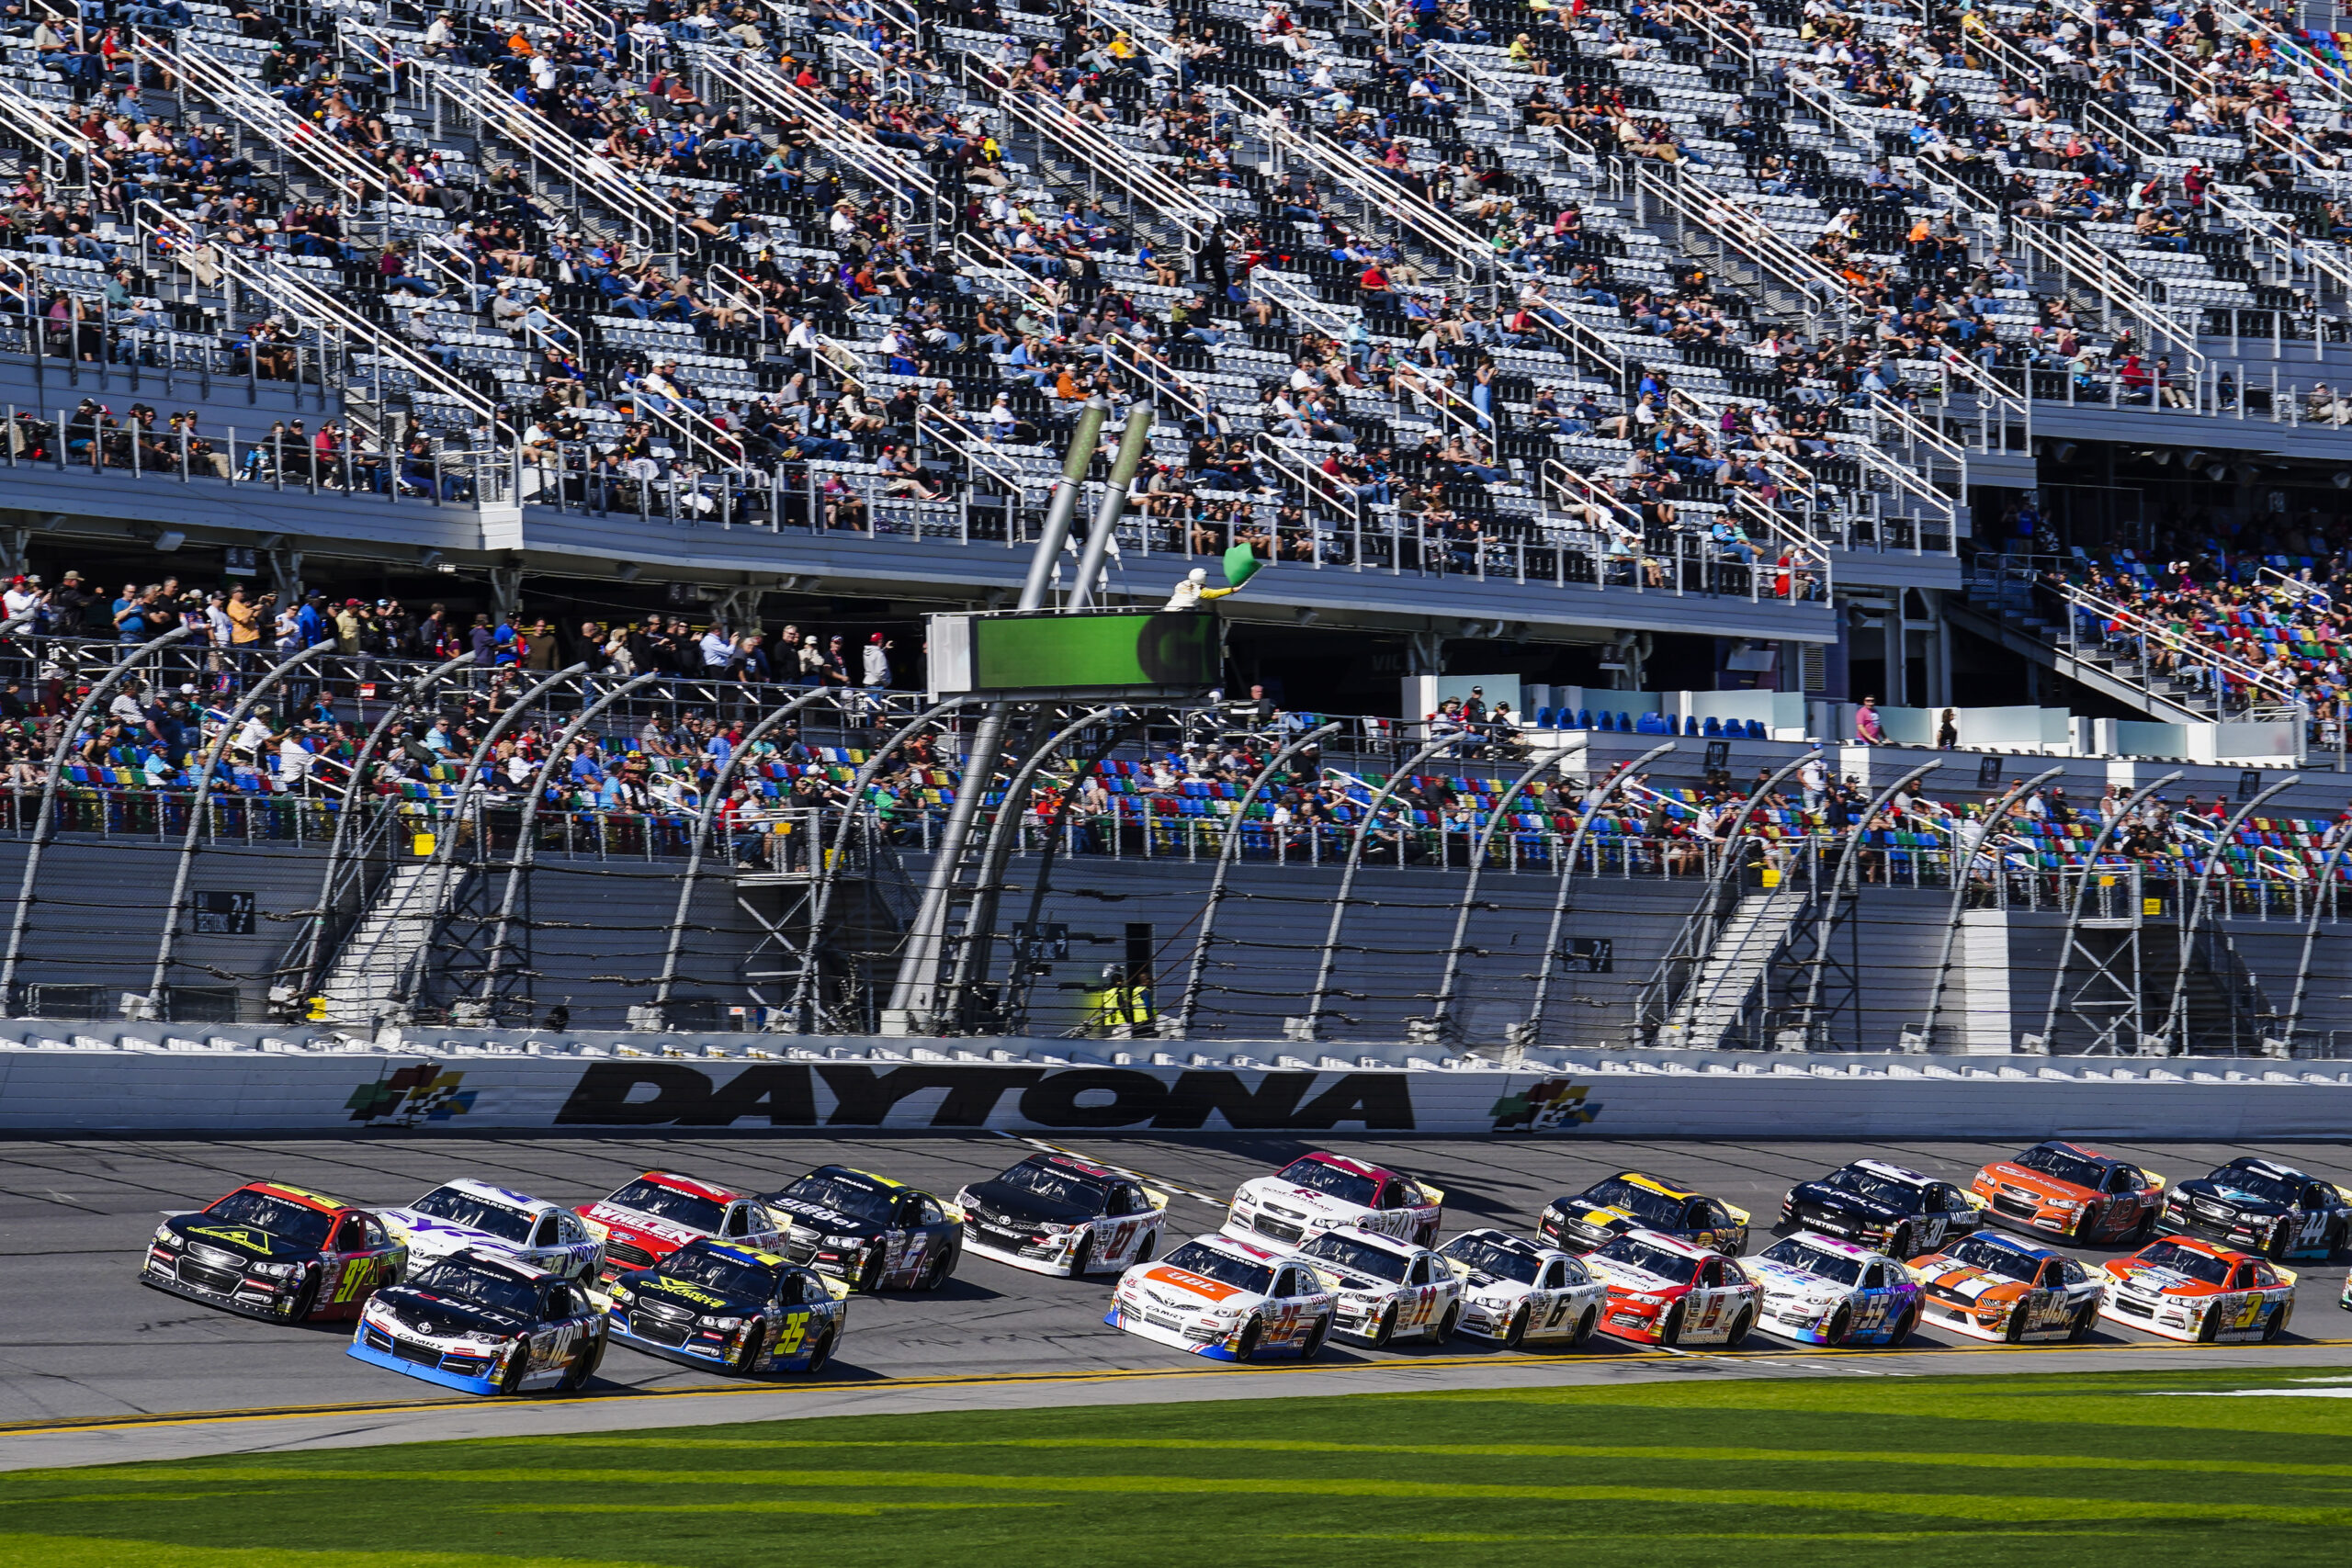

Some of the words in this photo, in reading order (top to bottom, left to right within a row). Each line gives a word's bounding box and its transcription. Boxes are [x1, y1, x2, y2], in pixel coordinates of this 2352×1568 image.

[554, 1062, 1415, 1132] DAYTONA
[833, 1176, 874, 1191] MENARDS
[1043, 1167, 1081, 1182] MENARDS
[263, 1195, 308, 1212] MENARDS
[458, 1192, 514, 1212] MENARDS
[658, 1184, 699, 1200] MENARDS
[588, 1205, 699, 1245] WHELEN
[980, 1223, 1023, 1240] CAMRY
[1802, 1215, 1848, 1235] MUSTANG
[1922, 1218, 1948, 1247] 30
[2300, 1211, 2329, 1246] 44
[1104, 1220, 1139, 1259] 27
[1634, 1241, 1679, 1259] MENARDS
[1800, 1243, 1846, 1260] MENARDS
[1984, 1242, 2020, 1258] MENARDS
[707, 1250, 752, 1268] MENARDS
[1209, 1247, 1260, 1269] MENARDS
[1290, 1255, 1384, 1286] MAGNUM
[334, 1258, 371, 1303] 97
[468, 1266, 513, 1282] MENARDS
[386, 1286, 481, 1314] Mobil
[1146, 1304, 1186, 1321] CAMRY
[1310, 1294, 1331, 1305] DEAN
[1412, 1286, 1437, 1325] 11
[1545, 1292, 1572, 1331] 6
[1697, 1292, 1725, 1331] 15
[1859, 1294, 1890, 1329] 55
[2042, 1291, 2069, 1324] 03
[2233, 1292, 2265, 1328] 3
[774, 1312, 809, 1355] 35
[1268, 1303, 1303, 1342] 25
[397, 1332, 445, 1349] CAMRY
[548, 1325, 575, 1368] 18
